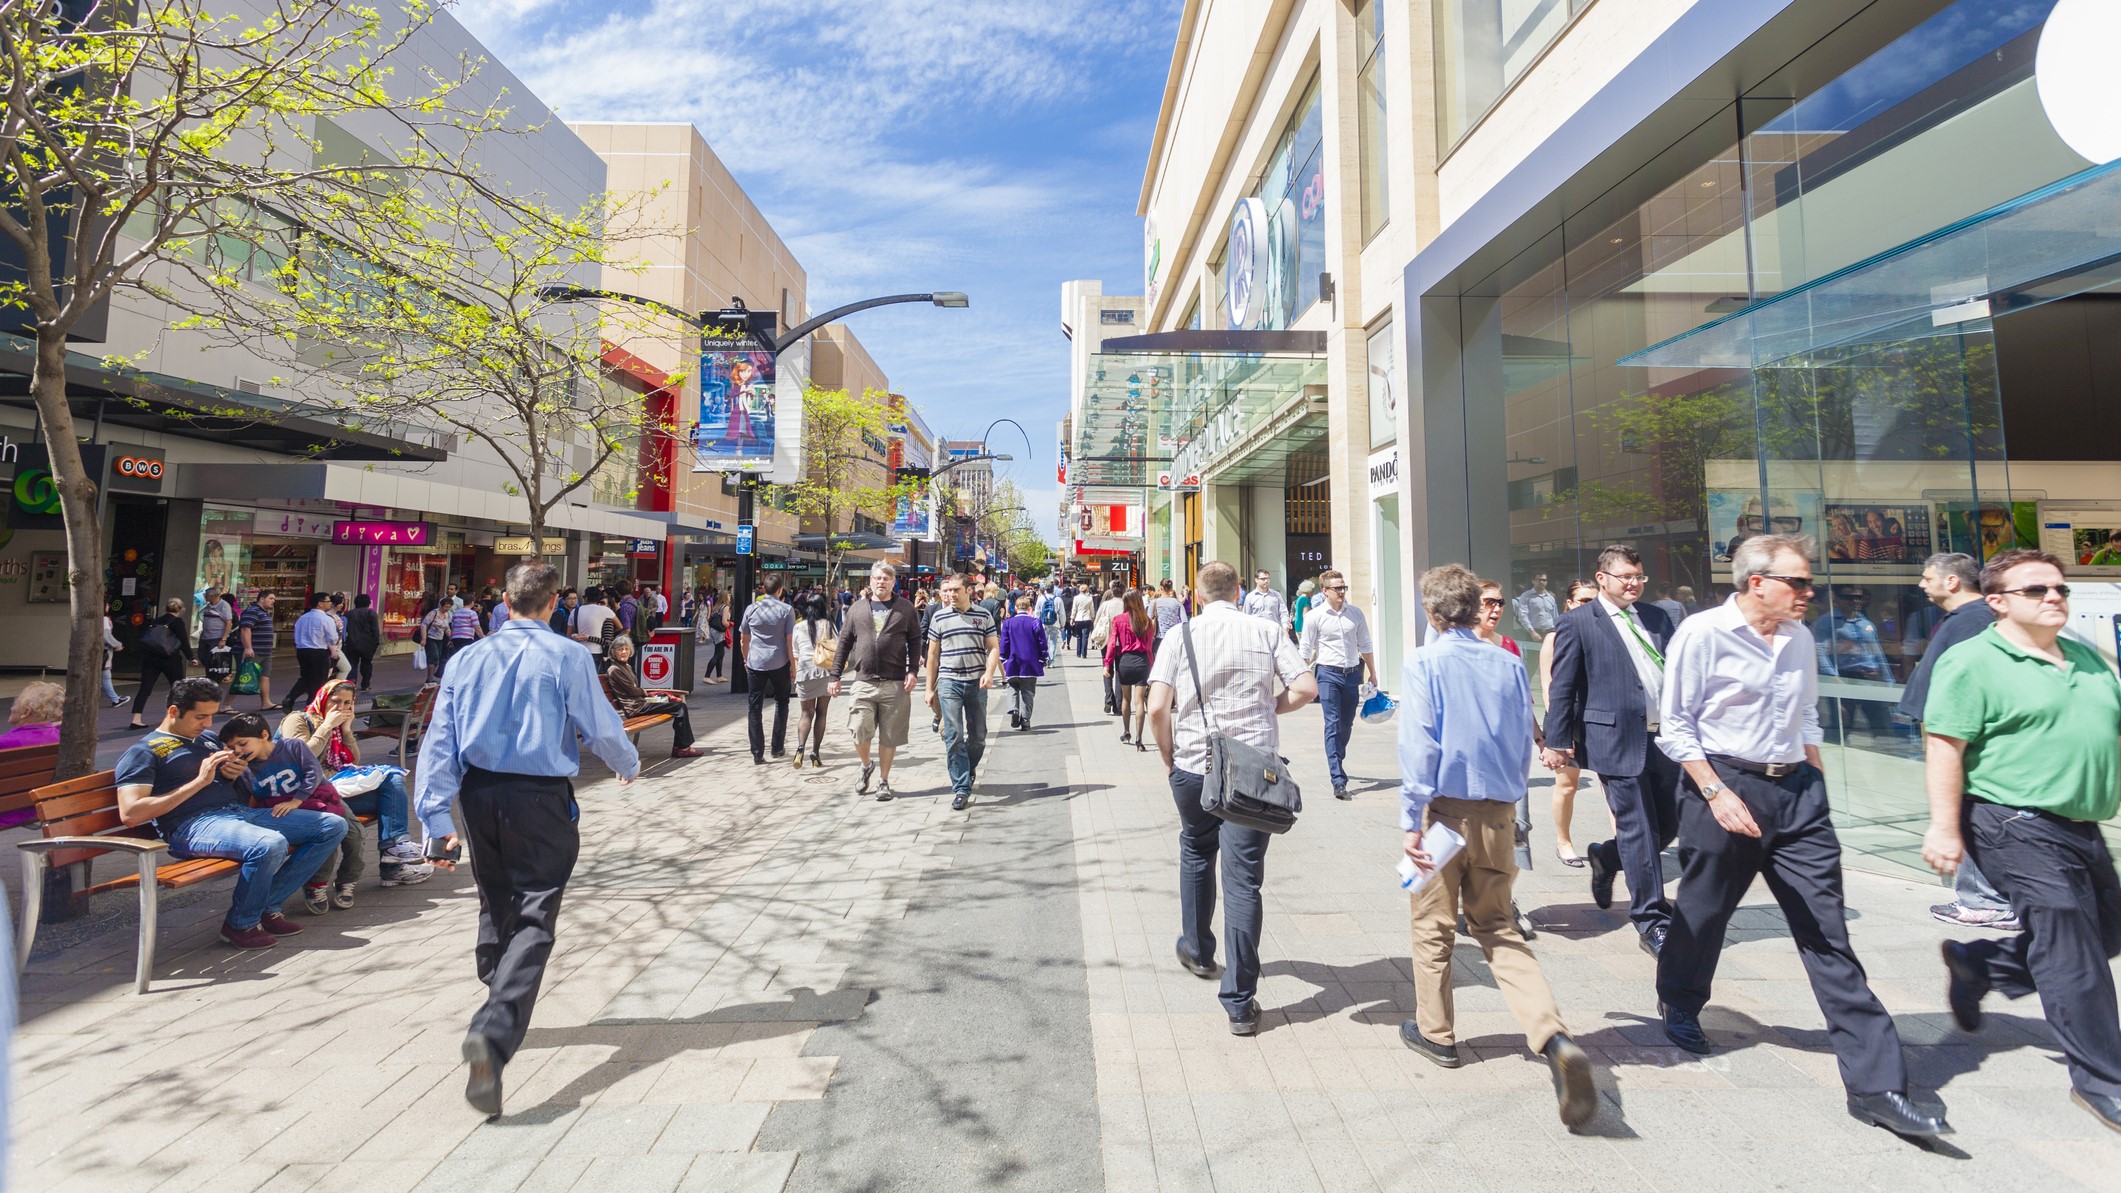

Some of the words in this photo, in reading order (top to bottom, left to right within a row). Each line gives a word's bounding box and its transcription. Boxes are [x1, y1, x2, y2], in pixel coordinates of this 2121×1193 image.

[704, 339, 734, 348] Uniquely
[1057, 440, 1066, 484] Kmart
[121, 459, 162, 476] BWS
[1160, 475, 1199, 485] ces
[281, 515, 332, 536] diva
[341, 525, 398, 541] diva
[498, 541, 518, 551] bras
[542, 543, 562, 553] ings
[636, 544, 656, 552] Jeans
[1301, 552, 1323, 561] TED
[406, 562, 425, 572] SALE
[1111, 562, 1129, 571] ZU
[383, 612, 398, 622] ALE
[401, 617, 421, 628] SALE
[258, 768, 300, 797] 72
